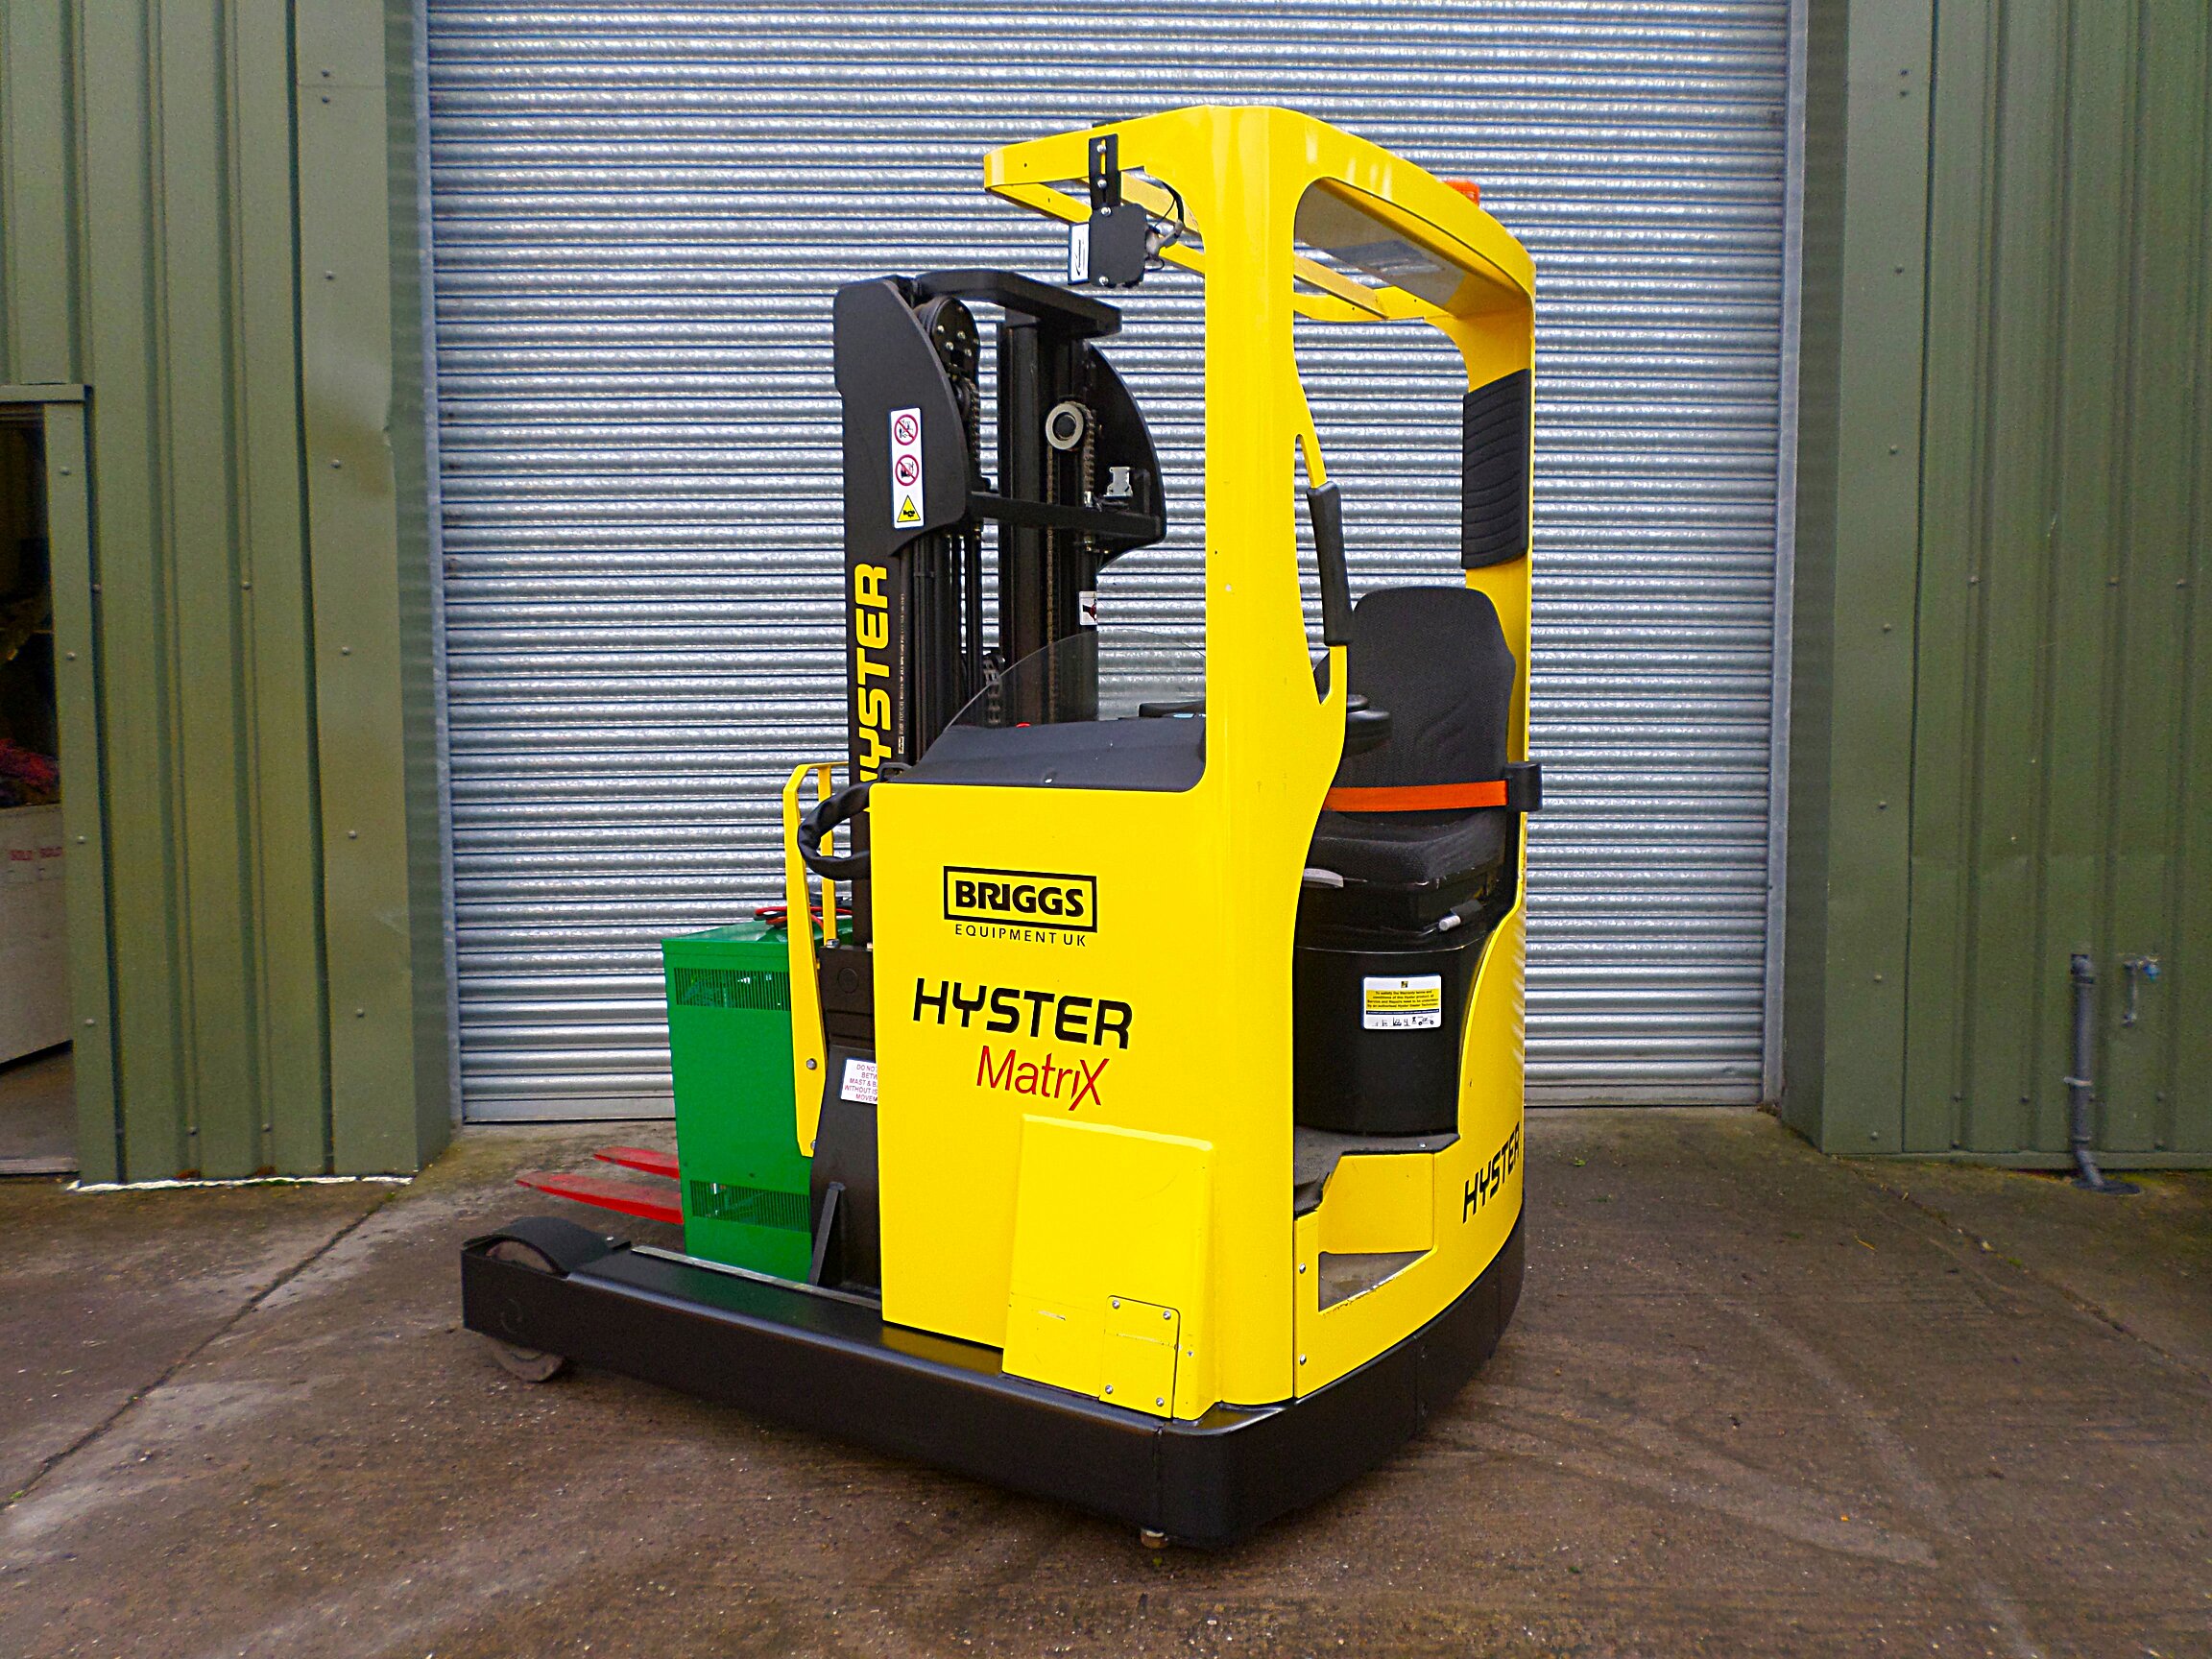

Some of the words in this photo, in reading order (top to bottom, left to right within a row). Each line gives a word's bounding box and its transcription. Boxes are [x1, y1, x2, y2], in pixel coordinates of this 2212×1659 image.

[854, 563, 892, 782] YSTER
[955, 879, 1084, 918] BRIGGS
[954, 924, 1057, 945] EQUIPMENT
[1063, 933, 1086, 948] UK
[912, 977, 1133, 1049] HYSTER
[845, 1085, 871, 1094] WITHOUT
[850, 1077, 866, 1086] MAST
[976, 1046, 1110, 1112] MatriX
[1462, 1121, 1520, 1225] HYSTER
